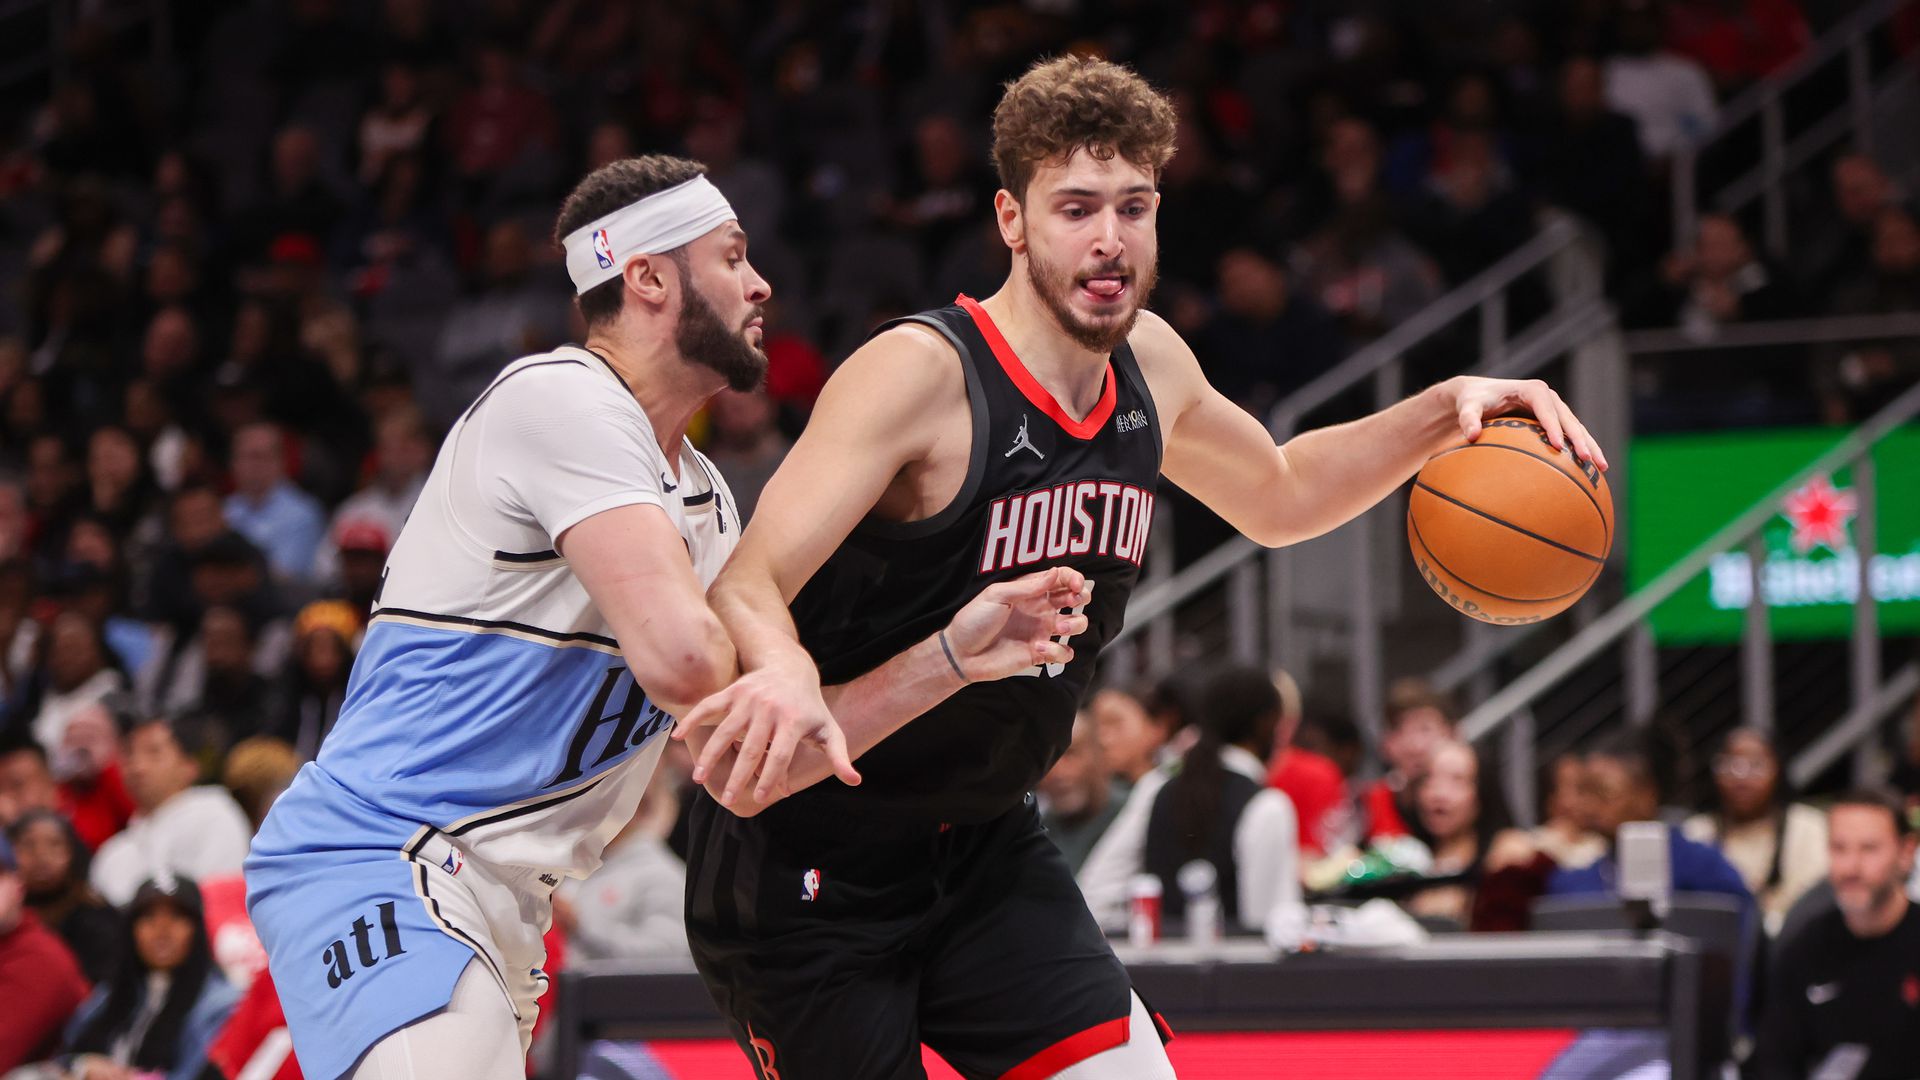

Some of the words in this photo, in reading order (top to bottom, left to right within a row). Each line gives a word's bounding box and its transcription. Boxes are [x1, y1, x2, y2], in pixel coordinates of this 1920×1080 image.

[979, 479, 1154, 574] HOUSTON
[1420, 558, 1541, 624] Wilson
[541, 667, 673, 789] Ha
[323, 901, 407, 989] atl
